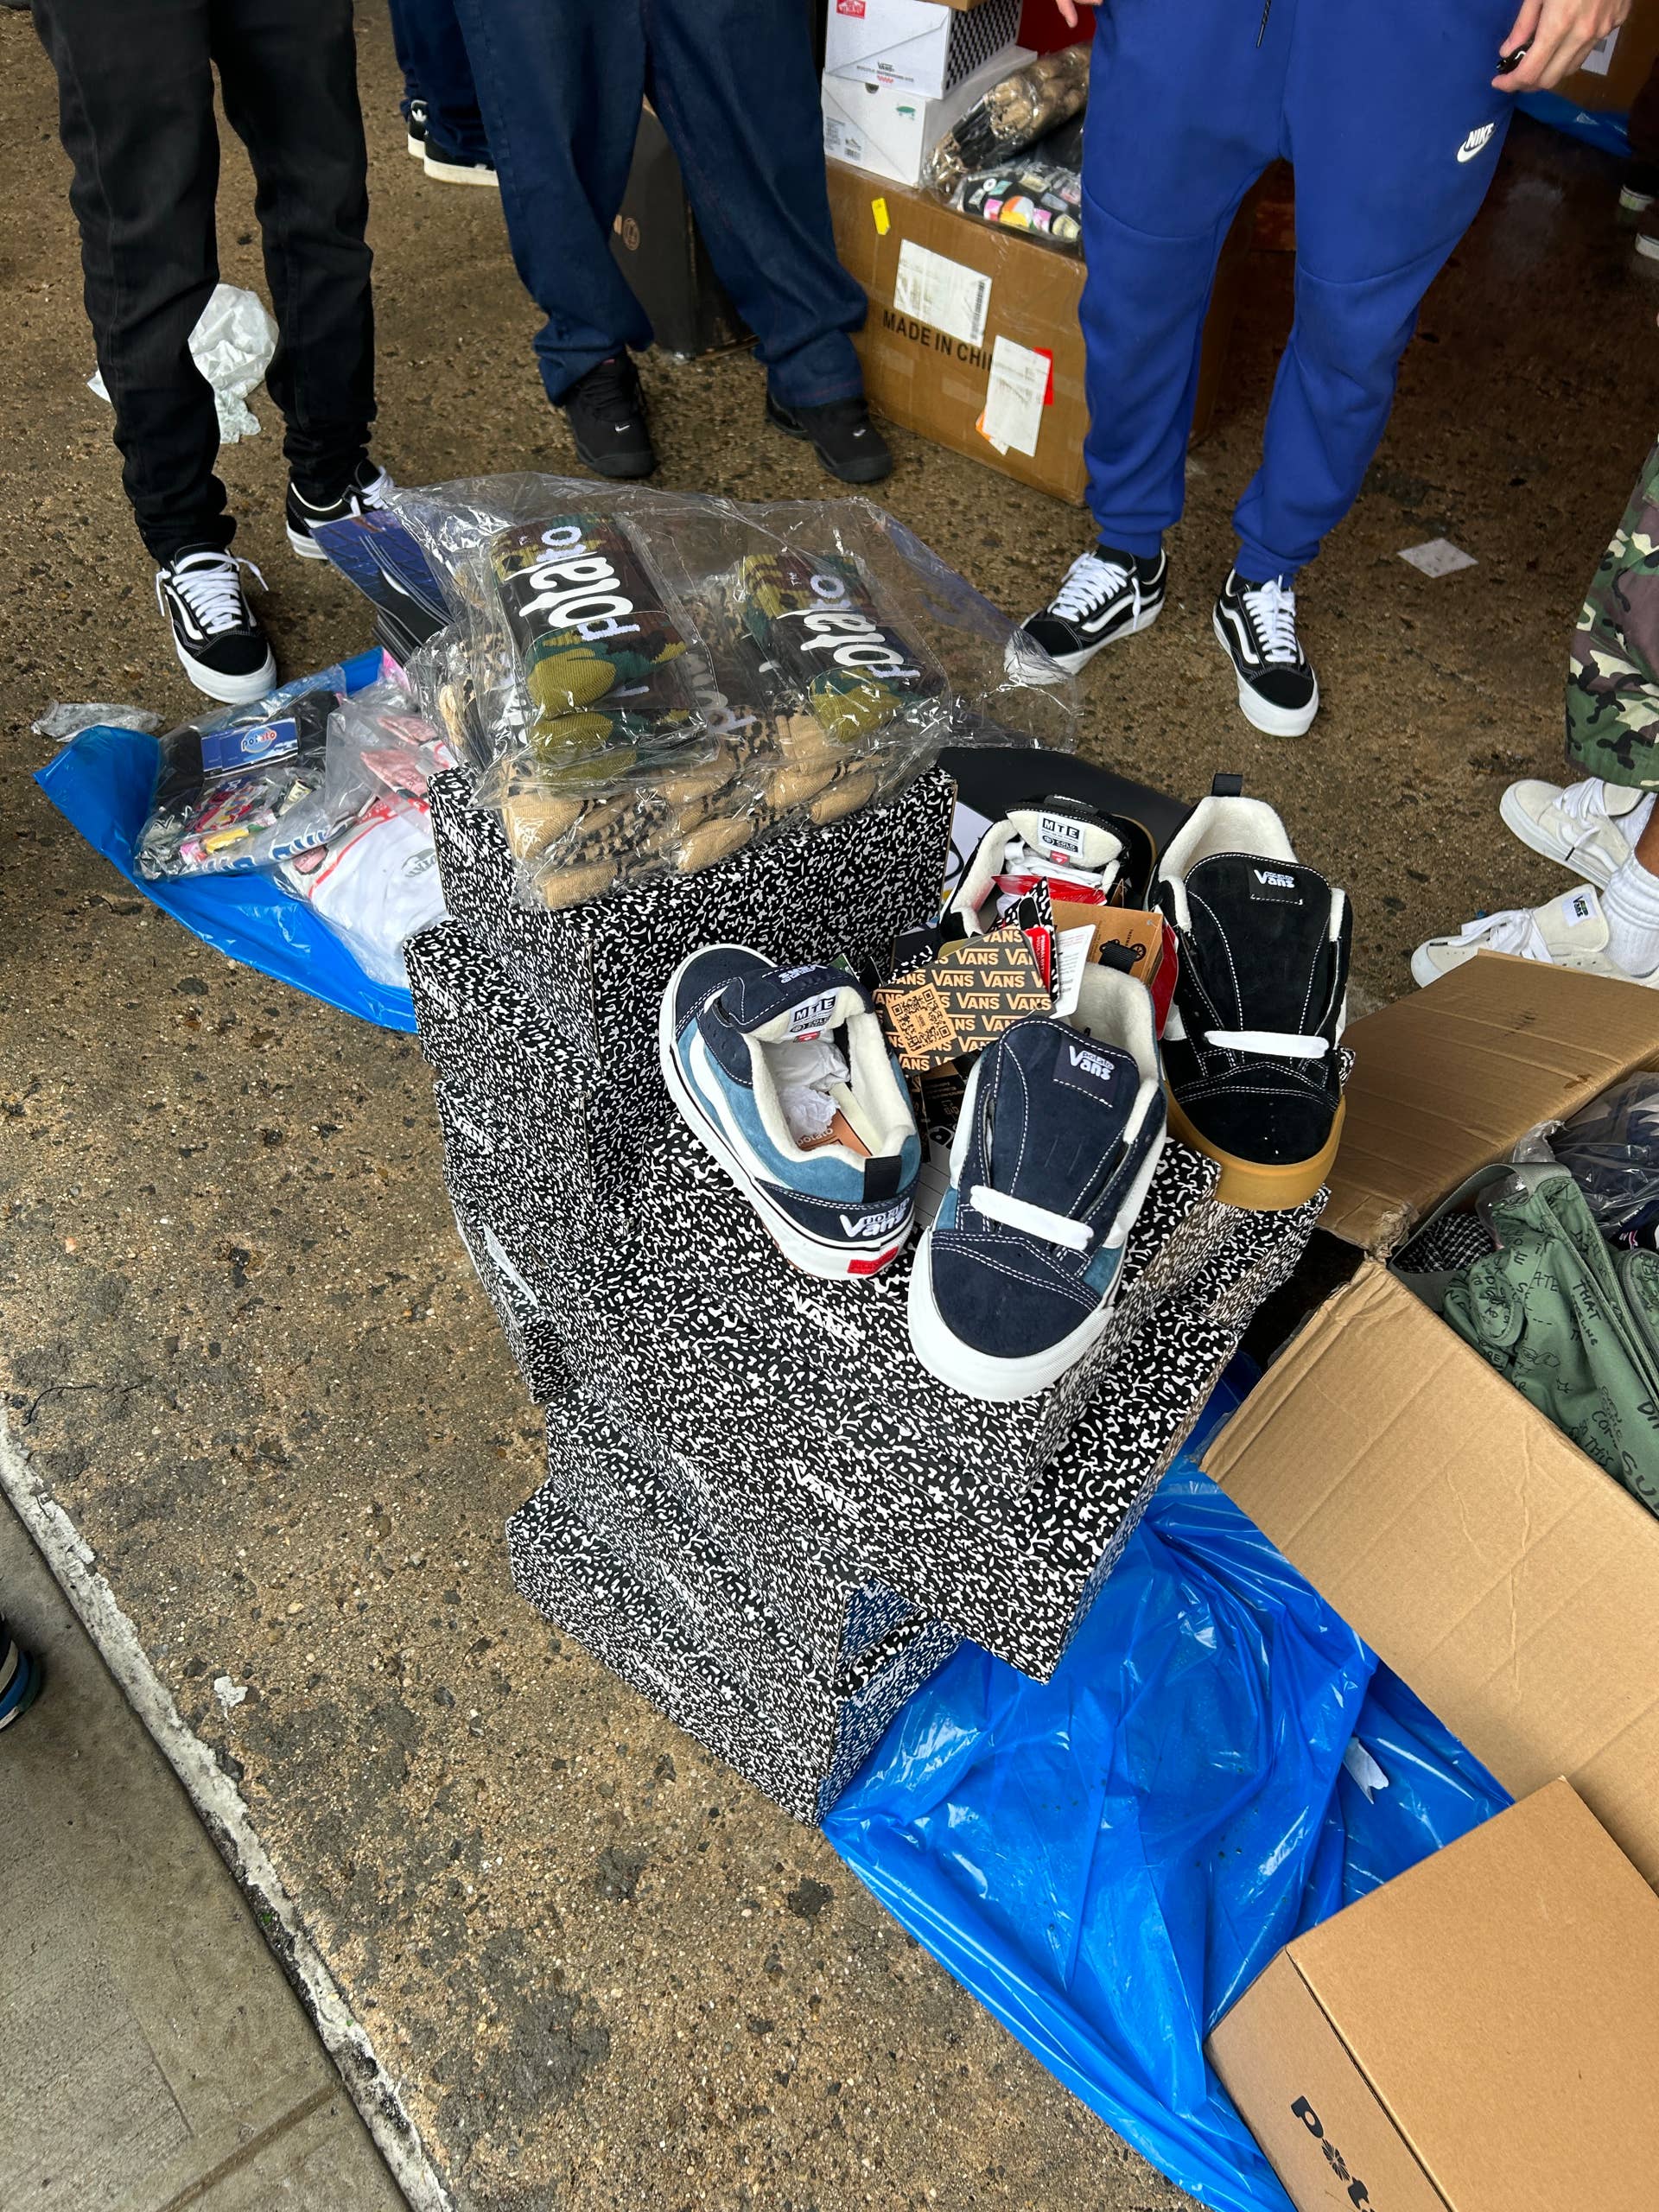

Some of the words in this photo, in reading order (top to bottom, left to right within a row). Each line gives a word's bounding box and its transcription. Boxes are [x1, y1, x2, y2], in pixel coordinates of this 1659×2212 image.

[1465, 123, 1495, 148] NIKE
[883, 310, 931, 346] MADE
[936, 334, 952, 355] IN
[957, 344, 994, 373] CHI
[1042, 817, 1080, 839] MTE
[1254, 869, 1294, 888] Vans
[956, 948, 1000, 965] VANS
[931, 969, 975, 988] VANS
[981, 970, 1026, 988] VANS
[793, 995, 836, 1022] MTE
[957, 993, 1001, 1009] VANS
[1006, 994, 1052, 1011] VANS
[1070, 1046, 1112, 1080] Vans
[796, 1126, 834, 1147] potato
[787, 1285, 865, 1354] VANS
[792, 1458, 864, 1520] VANS
